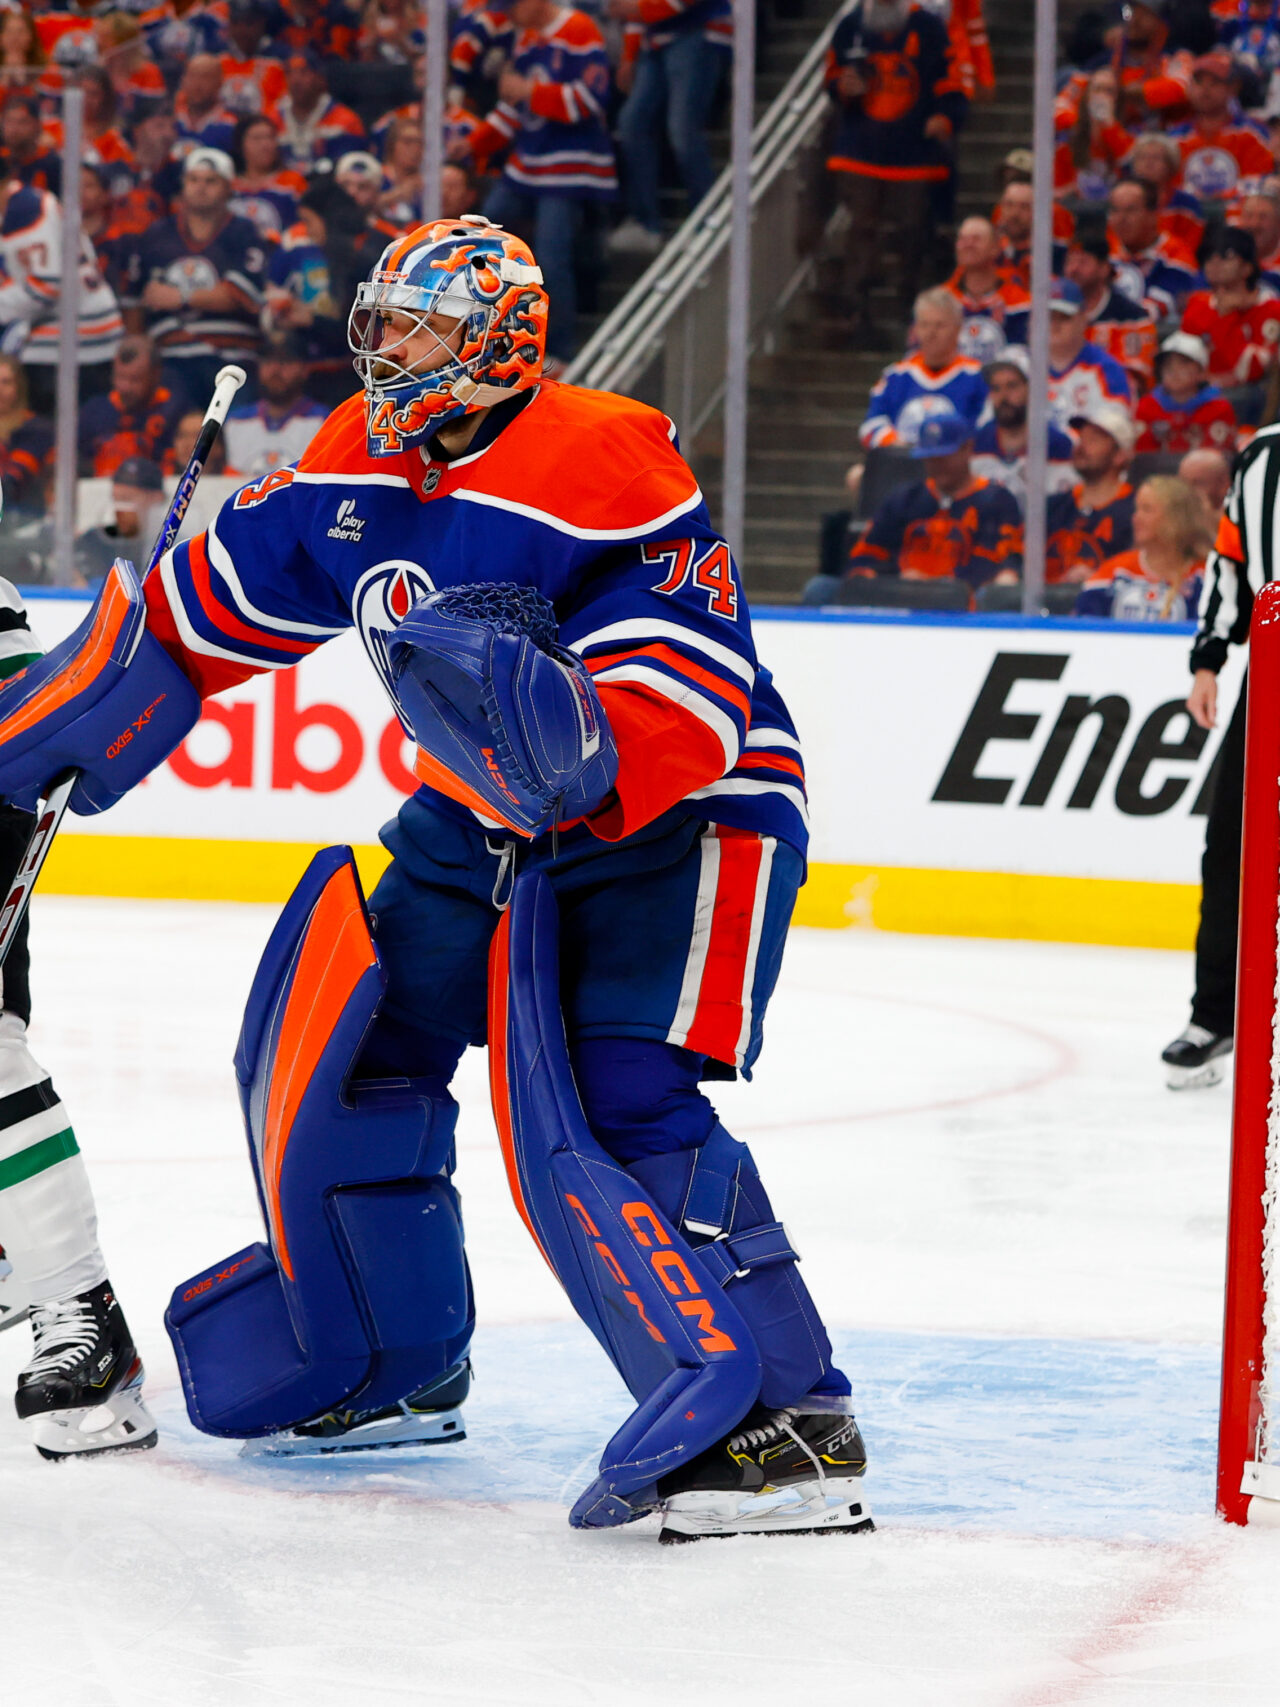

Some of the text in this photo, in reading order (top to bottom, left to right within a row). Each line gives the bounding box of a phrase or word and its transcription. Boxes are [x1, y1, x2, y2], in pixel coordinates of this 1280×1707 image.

[367, 397, 403, 453] 4
[173, 459, 203, 521] CCM
[326, 526, 363, 543] alberta
[341, 515, 366, 531] play
[640, 537, 738, 623] 74
[929, 651, 1225, 817] Ene
[480, 747, 521, 806] CCM
[620, 1201, 738, 1354] CCM
